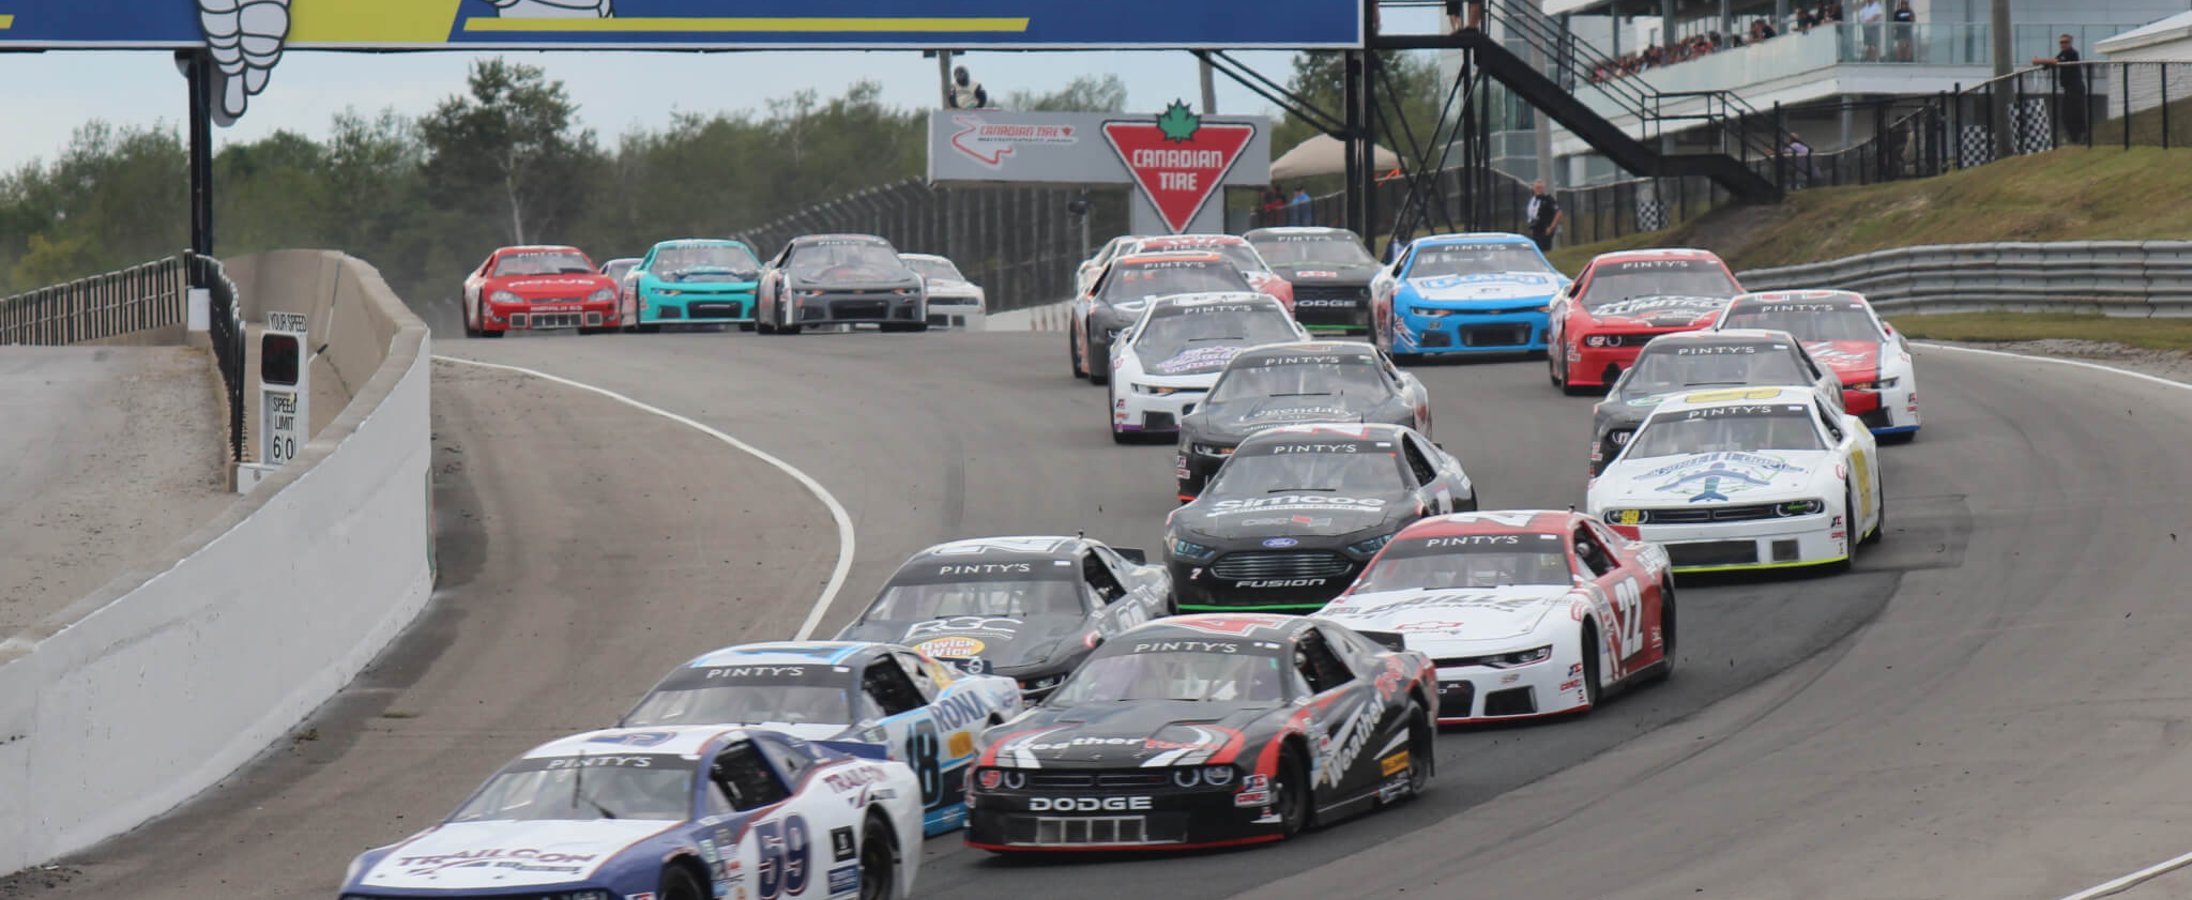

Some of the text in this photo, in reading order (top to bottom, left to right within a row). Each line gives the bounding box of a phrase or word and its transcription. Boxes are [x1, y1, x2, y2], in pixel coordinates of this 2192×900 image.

[1133, 149, 1223, 168] CANADIAN
[1159, 172, 1197, 191] TIRE
[1622, 260, 1690, 270] PINTY'S
[1183, 304, 1253, 315] PINTY'S
[1761, 303, 1835, 313] PINTY'S
[269, 313, 307, 332] YOUR SPEED
[1678, 346, 1756, 356] PINTY'S
[1264, 355, 1341, 366] PINTY'S
[273, 397, 296, 413] SPEED
[1688, 405, 1773, 419] PINTY'S
[274, 416, 294, 431] LIMIT
[273, 436, 294, 460] 60
[1273, 444, 1358, 455] PINTY'S
[1426, 535, 1520, 548] PINTY'S
[939, 563, 1032, 575] PINTY'S
[1614, 576, 1644, 661] 22
[1133, 641, 1238, 653] PINTY'S
[706, 666, 805, 679] PINTY'S
[549, 753, 653, 770] PINTY'S
[905, 718, 940, 806] 18
[1029, 796, 1153, 811] DODGE
[398, 848, 598, 867] TRAILCON
[755, 815, 811, 900] 59
